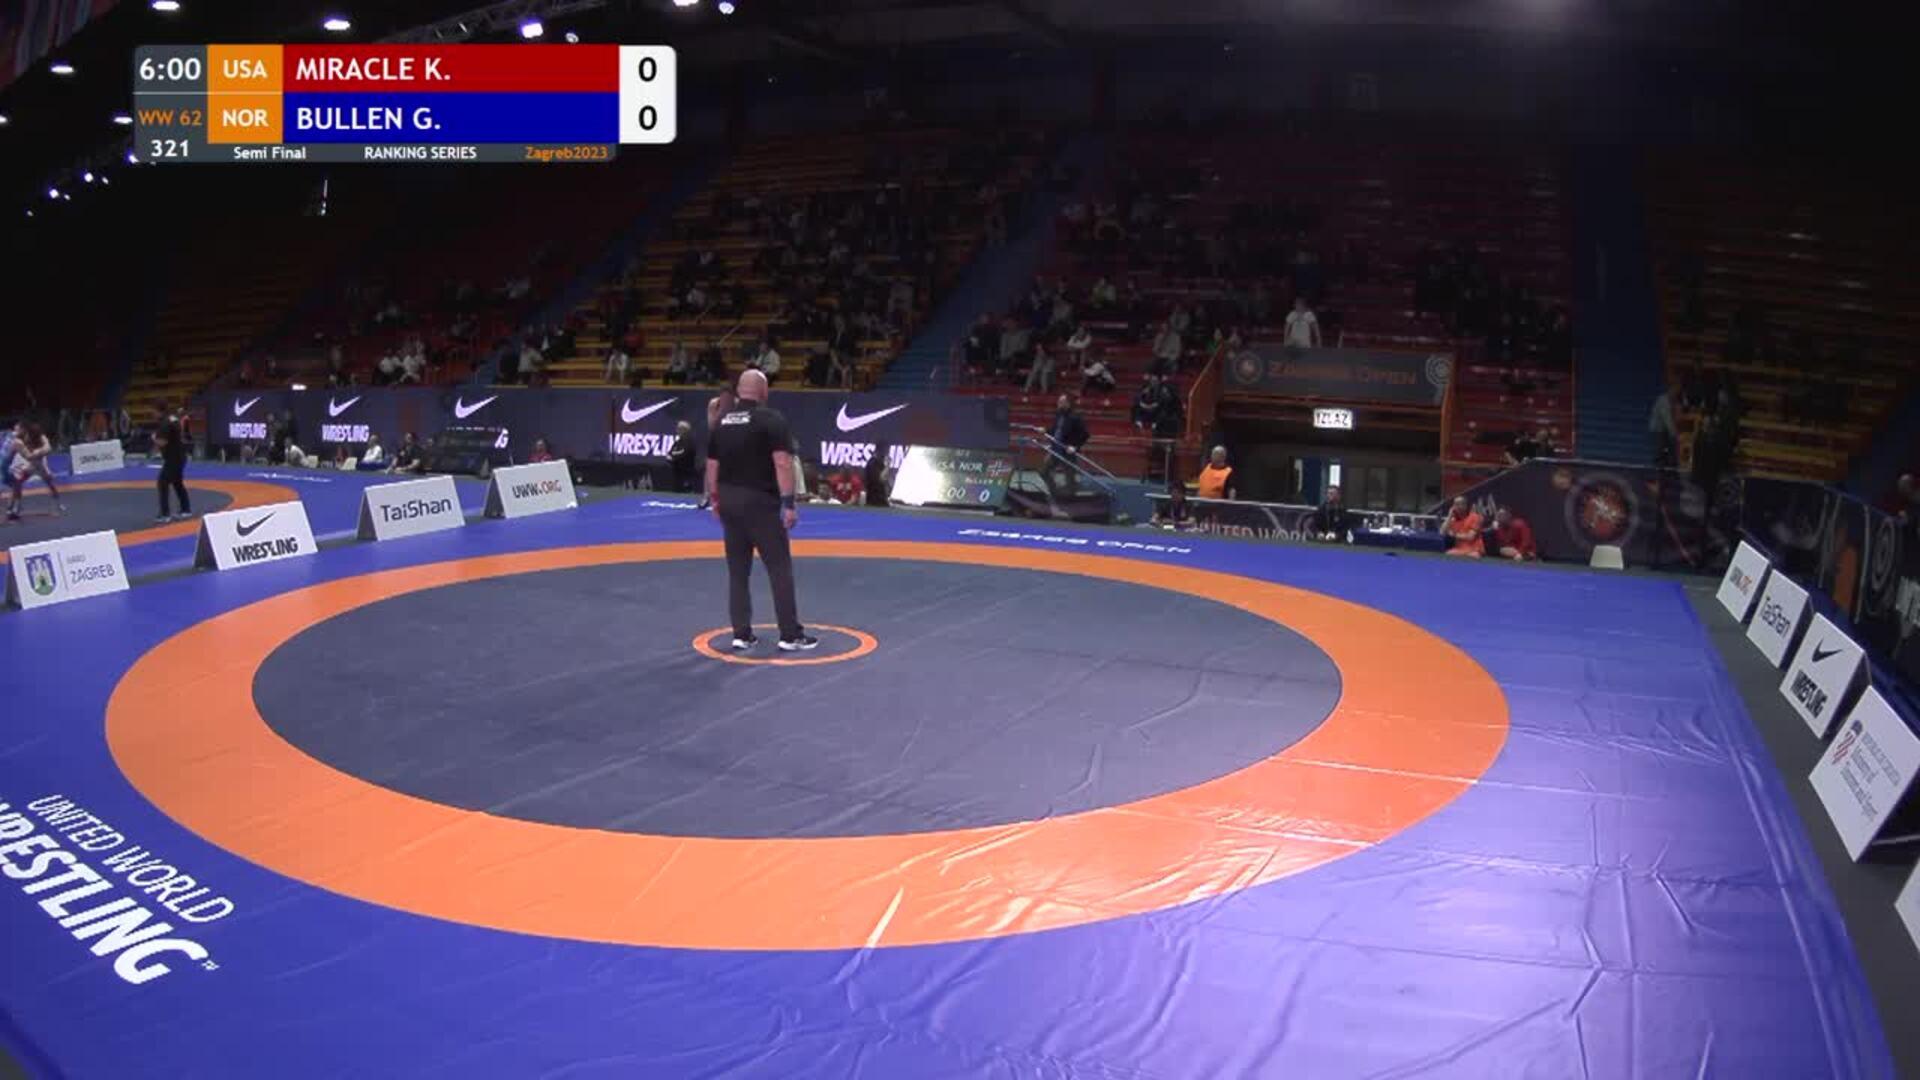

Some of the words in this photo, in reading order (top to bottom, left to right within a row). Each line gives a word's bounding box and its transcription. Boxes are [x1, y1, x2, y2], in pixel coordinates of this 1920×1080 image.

[380, 498, 452, 523] TaiShan
[232, 537, 298, 563] WRESTLING
[0, 798, 209, 984] RESTLING
[27, 795, 125, 851] UNITED
[102, 846, 235, 923] WORLD
